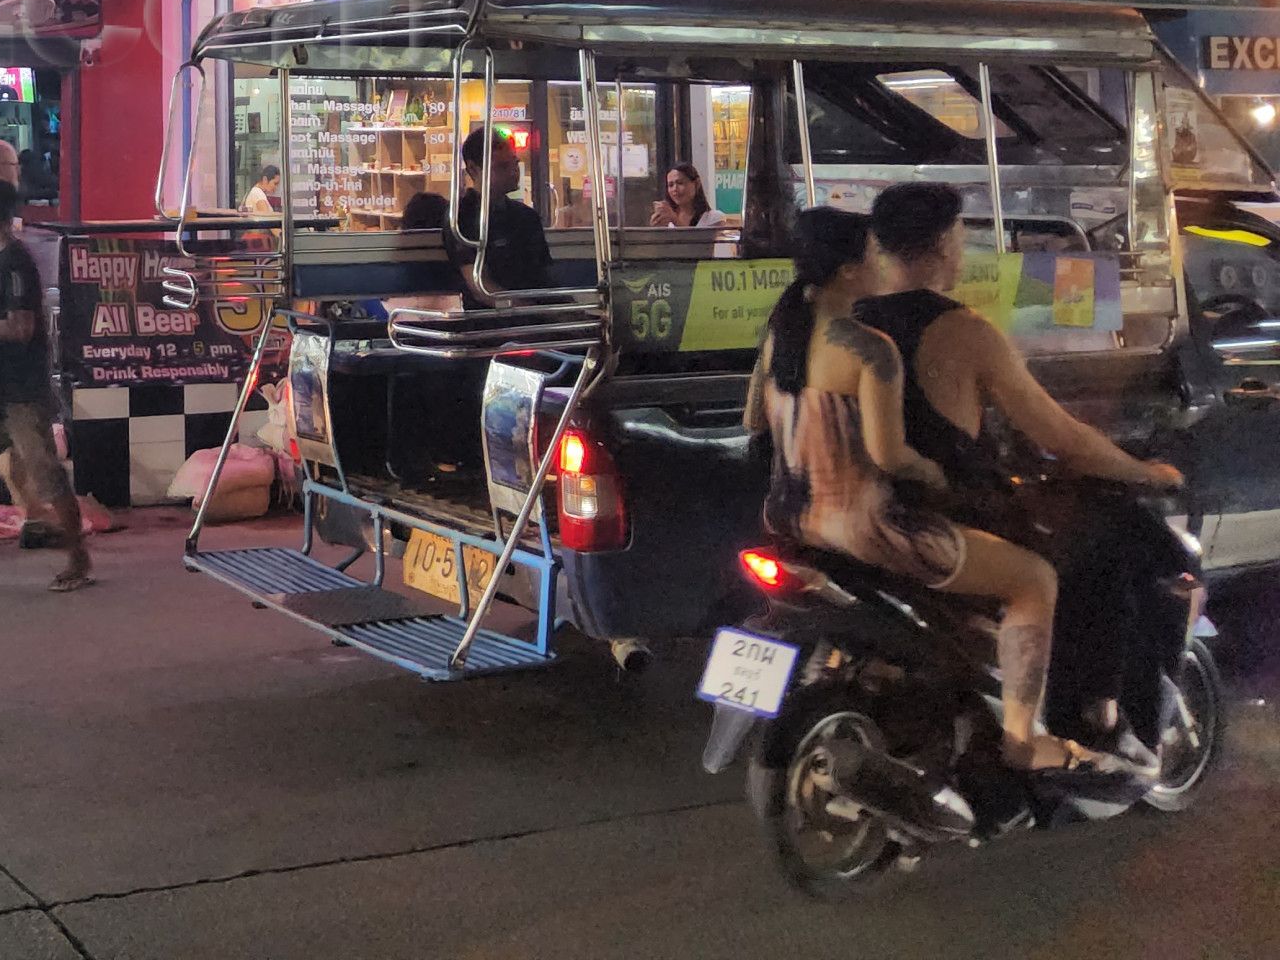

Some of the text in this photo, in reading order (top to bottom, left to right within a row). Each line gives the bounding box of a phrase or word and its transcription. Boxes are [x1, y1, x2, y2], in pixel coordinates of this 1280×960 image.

[1210, 36, 1280, 69] EXC
[291, 100, 311, 110] hai
[323, 100, 380, 113] Massage
[422, 102, 446, 114] 180
[291, 132, 311, 142] oot
[318, 132, 376, 144] Massage
[308, 164, 365, 176] Massage
[339, 195, 398, 207] Shoulder
[71, 247, 138, 286] Happy
[647, 283, 671, 297] AIS
[711, 271, 747, 291] NO.1
[93, 304, 199, 336] All Beer
[630, 299, 671, 339] 5G
[83, 343, 151, 362] Everyday
[156, 343, 177, 357] 12
[209, 344, 238, 358] pm.
[93, 362, 229, 381] Drink Responsibly
[720, 682, 760, 707] 241
